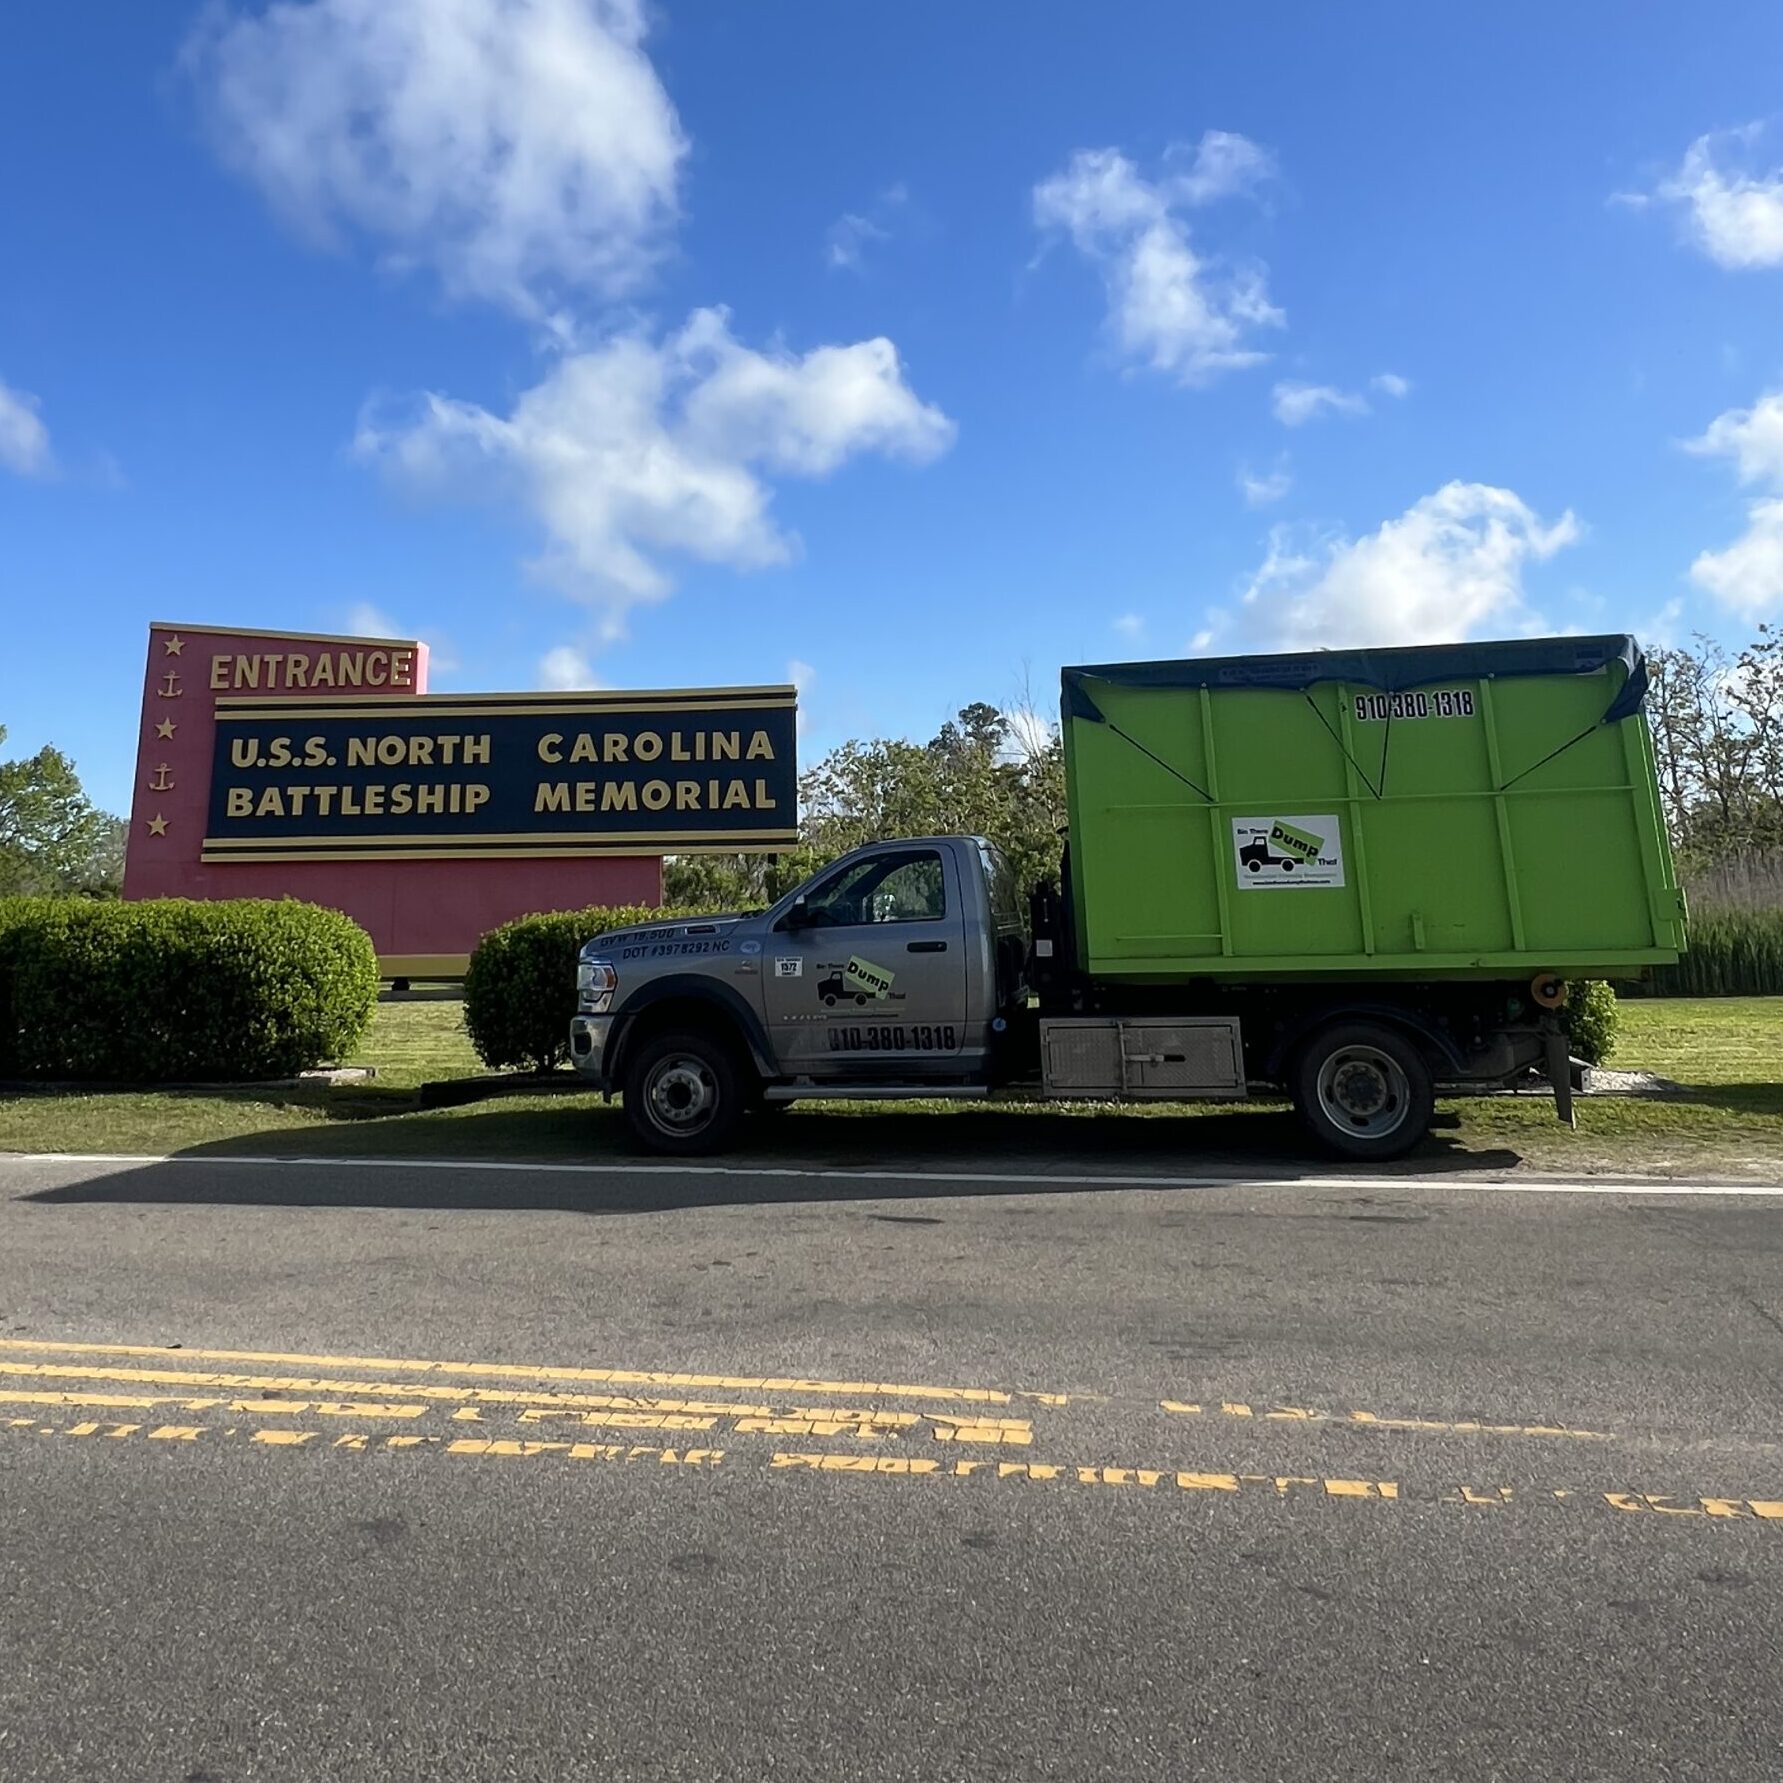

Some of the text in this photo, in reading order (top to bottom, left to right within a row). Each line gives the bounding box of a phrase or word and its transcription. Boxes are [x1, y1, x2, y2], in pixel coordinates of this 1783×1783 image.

[210, 651, 412, 690] ENTRANCE
[1355, 690, 1474, 720] 910380-1318
[231, 730, 775, 768] U.S.S. NORTH CAROLINA
[226, 779, 776, 817] BATTLESHIP MEMORIAL
[1271, 826, 1319, 857] Dump
[623, 946, 649, 960] DOT
[712, 940, 730, 952] NC
[847, 961, 889, 992] Dump
